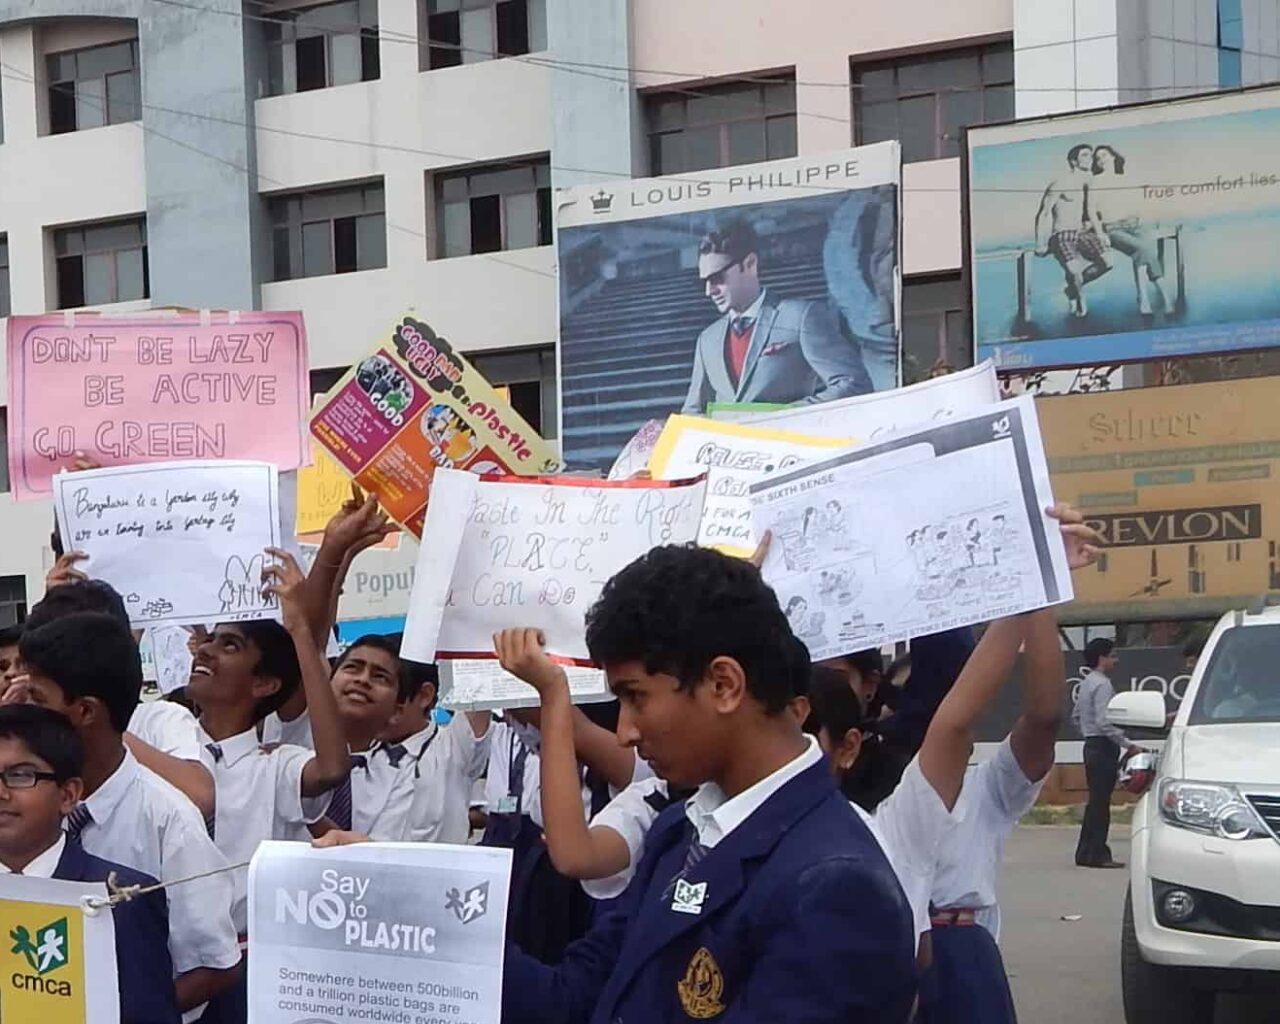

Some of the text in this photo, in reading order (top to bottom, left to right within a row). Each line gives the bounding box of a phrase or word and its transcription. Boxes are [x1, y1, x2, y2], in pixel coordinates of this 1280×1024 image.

[630, 159, 861, 208] LOUIS PHILIPPE
[1141, 171, 1277, 201] True comfort lies
[32, 332, 275, 365] DON'T BE LAZY
[400, 325, 437, 361] GOOD
[406, 345, 441, 381] UGLY
[84, 372, 277, 407] BE ACTIVE
[370, 391, 404, 427] GOOD
[33, 420, 226, 461] GO GREEN
[767, 485, 798, 503] SIXTH
[800, 473, 836, 493] SENSE
[1083, 510, 1251, 545] REVLON
[472, 572, 526, 607] Can
[321, 869, 370, 900] Say
[275, 888, 346, 930] NO
[350, 902, 368, 919] to
[345, 920, 437, 954] PLASTIC
[11, 970, 72, 998] cmca
[279, 968, 354, 988] Somewhere
[358, 975, 413, 993] between
[278, 998, 344, 1017] consumed
[347, 1006, 411, 1024] worldwide
[279, 984, 460, 1014] and a trillion plastic bags are
